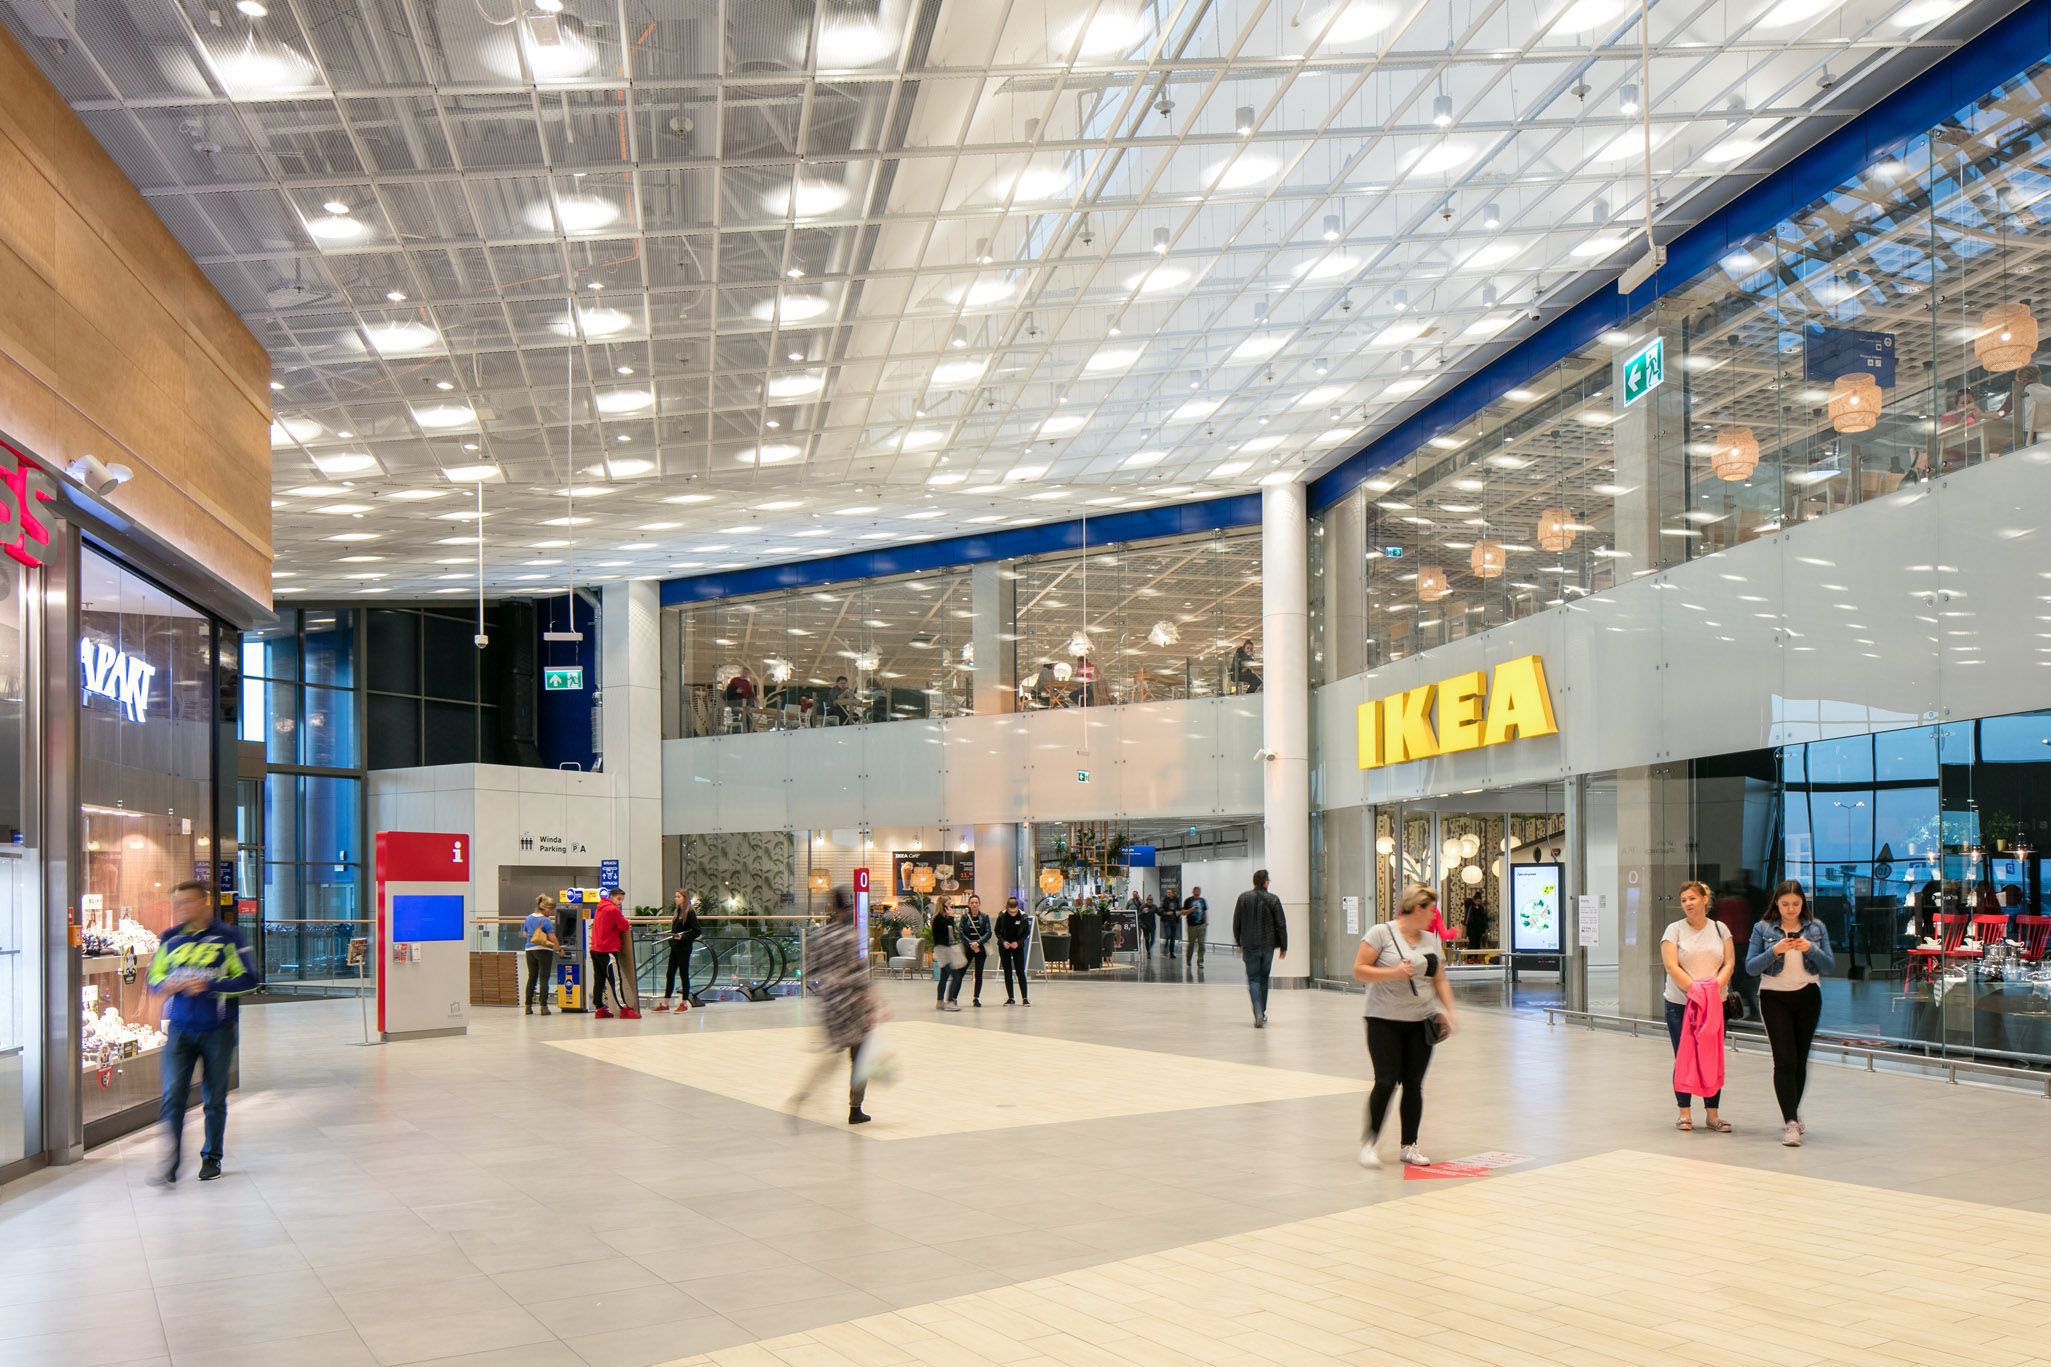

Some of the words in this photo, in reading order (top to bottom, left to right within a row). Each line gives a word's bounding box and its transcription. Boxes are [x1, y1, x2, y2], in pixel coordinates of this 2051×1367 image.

[1357, 654, 1559, 769] IKEA
[540, 845, 567, 854] Parking
[579, 845, 587, 853] A
